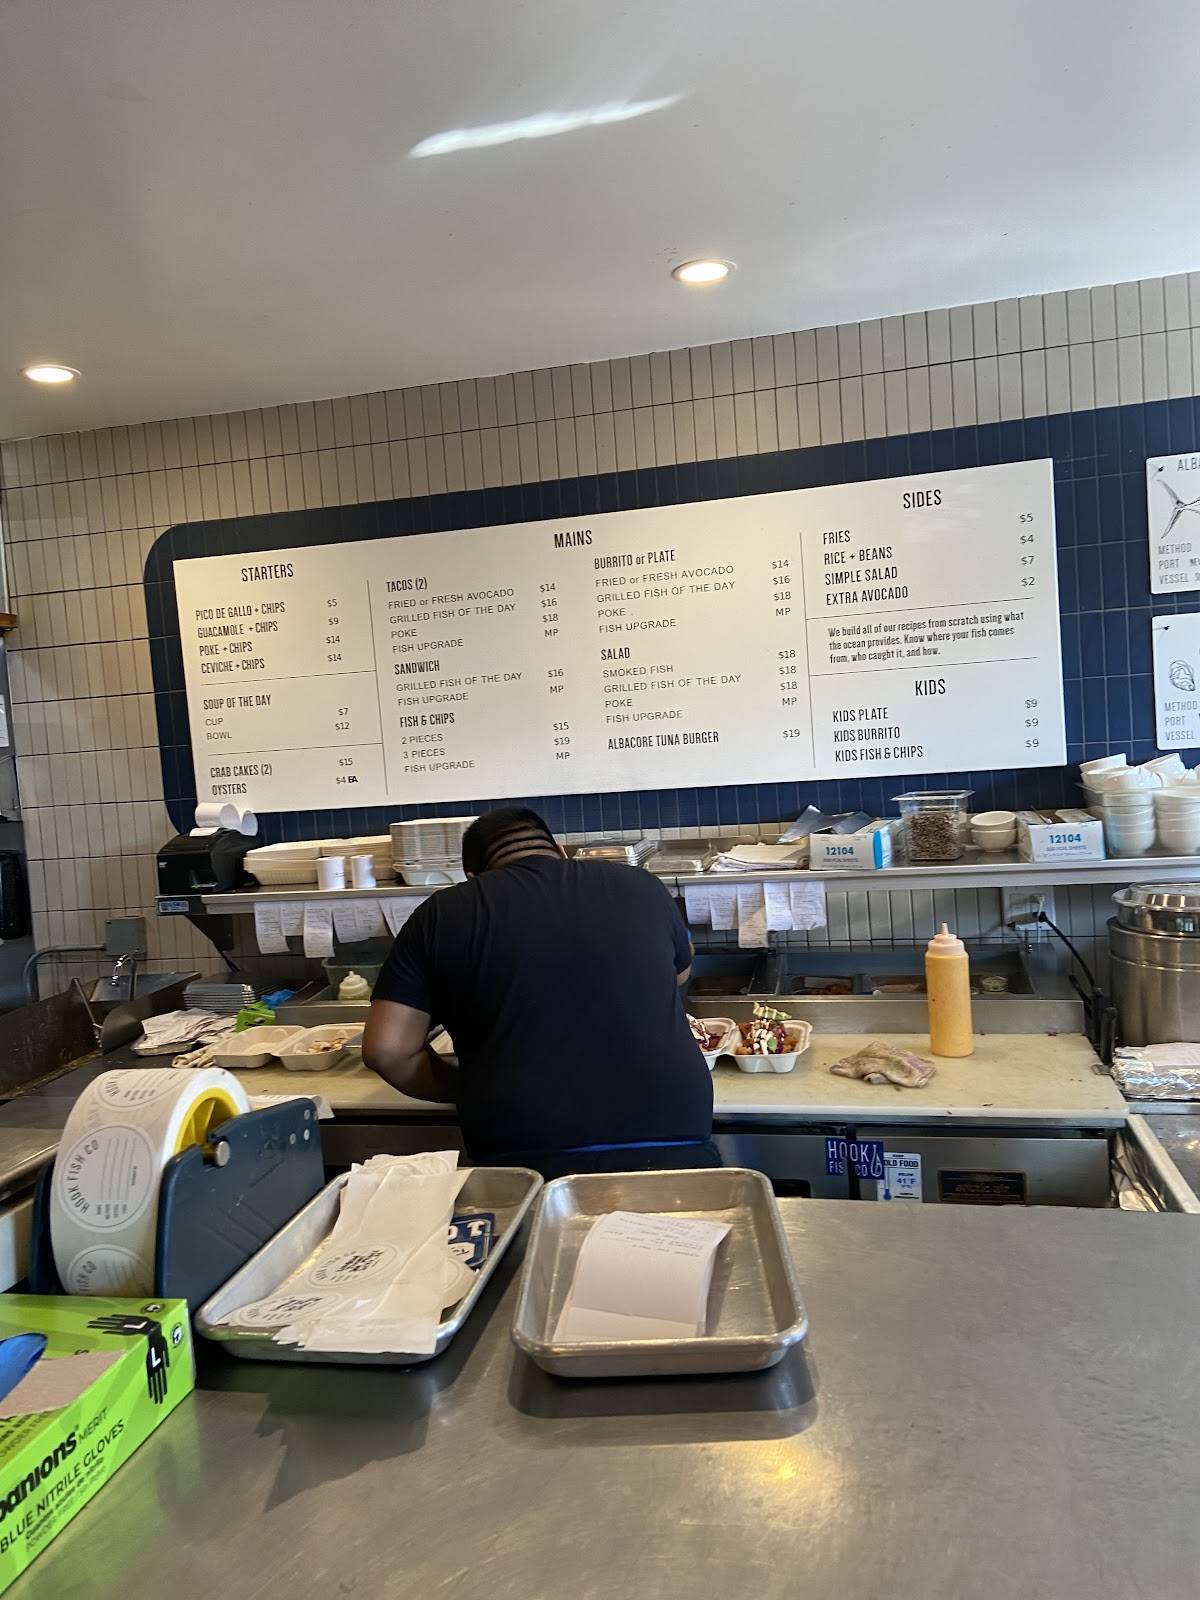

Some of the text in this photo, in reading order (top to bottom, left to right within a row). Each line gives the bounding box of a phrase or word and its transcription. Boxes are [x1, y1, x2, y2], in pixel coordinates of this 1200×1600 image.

[1177, 458, 1200, 472] ALB
[902, 488, 942, 509] SIDES
[1019, 512, 1033, 523] $5
[553, 529, 592, 548] MAINS
[822, 529, 850, 545] FRIES
[1019, 533, 1034, 544] $4
[823, 545, 892, 565] RICE BEANS
[1158, 542, 1192, 554] METHOD
[593, 548, 675, 570] BURRITO or PLATE
[771, 558, 789, 569] $14
[1020, 554, 1034, 566] $7
[1158, 558, 1180, 570] PORT
[240, 562, 294, 582] STARTERS
[824, 566, 897, 586] SIMPLE SALAD
[1159, 572, 1189, 584] VESSEL
[385, 576, 427, 592] TACOS (2)
[772, 574, 790, 585] $16
[1020, 576, 1035, 587] $2
[539, 582, 555, 592] $14
[596, 580, 735, 602] GRILLED FISH OF THE DAY
[326, 598, 337, 607] $5
[387, 598, 416, 609] FRIED
[431, 593, 463, 604] FRESH
[466, 587, 514, 600] AVOCADO
[540, 597, 557, 608] $16
[772, 590, 791, 601] $18
[825, 585, 908, 606] EXTRA AVOCADO
[195, 600, 285, 620] PICO DE GALLO CHIPS
[389, 602, 516, 624] GRILLED FISH OF THE DAY
[327, 616, 339, 626] $9
[541, 612, 558, 623] $18
[827, 610, 1024, 637] We build all of our recipes from scratch using what
[196, 620, 278, 638] GUACAMOLE CHIPS
[544, 628, 558, 637] MP
[598, 618, 676, 633] FISH UPGRADE
[325, 634, 340, 644] $14
[390, 628, 417, 638] POKE
[828, 640, 841, 650] the
[842, 640, 866, 649] ocean
[903, 633, 925, 644] Know
[926, 631, 950, 642] where
[951, 630, 969, 642] your
[970, 627, 986, 638] fish
[987, 626, 1014, 637] comes
[198, 640, 252, 656] POKE CHIPS
[392, 638, 464, 653] FISH UPGRADE
[326, 652, 342, 662] $14
[600, 646, 630, 660] SALAD
[850, 651, 866, 662] who
[867, 649, 894, 661] caught
[905, 646, 920, 657] and
[200, 657, 265, 674] CEVICHE CHIPS
[393, 659, 440, 675] SANDWICH
[602, 664, 673, 678] SMOKED FISH
[547, 668, 564, 678] $16
[914, 678, 946, 696] KIDS
[202, 694, 271, 710] SOUP OF THE DAY
[1024, 698, 1037, 709] $9
[1164, 700, 1198, 712] METHOD
[337, 707, 348, 716] $7
[832, 706, 888, 722] KIDS PLATE
[204, 717, 224, 726] CUP
[334, 721, 350, 730] $12
[399, 711, 455, 727] FISH & CHIPS
[552, 720, 569, 731] $15
[1024, 717, 1038, 728] $9
[1164, 716, 1185, 726] PORT
[205, 731, 232, 740] BOWL
[400, 732, 443, 744] 2 PIECES
[607, 730, 719, 750] ALBACORE TUNA BURGER
[782, 728, 800, 738] $19
[833, 725, 900, 742] KIDS BURRITO
[1166, 730, 1194, 740] VESSEL
[1024, 738, 1039, 748] $9
[834, 744, 923, 762] KIDS FISH & CHIPS
[338, 757, 353, 766] $15
[209, 763, 272, 778] CRAB CAKES (2)
[335, 775, 358, 784] $4 EA
[211, 782, 247, 796] OYSTERS
[1049, 833, 1082, 844] 12104
[826, 846, 854, 856] 12104
[828, 1140, 870, 1162] HOOK
[829, 1161, 868, 1176] FIS CO
[899, 1160, 919, 1168] FOOD
[67, 1140, 99, 1214] HOOK FISH CO
[151, 1347, 162, 1368] L
[78, 1407, 108, 1444] MERIT
[0, 1514, 34, 1555] BLUE
[36, 1463, 81, 1515] NITRILE
[84, 1419, 124, 1467] GLOVES
